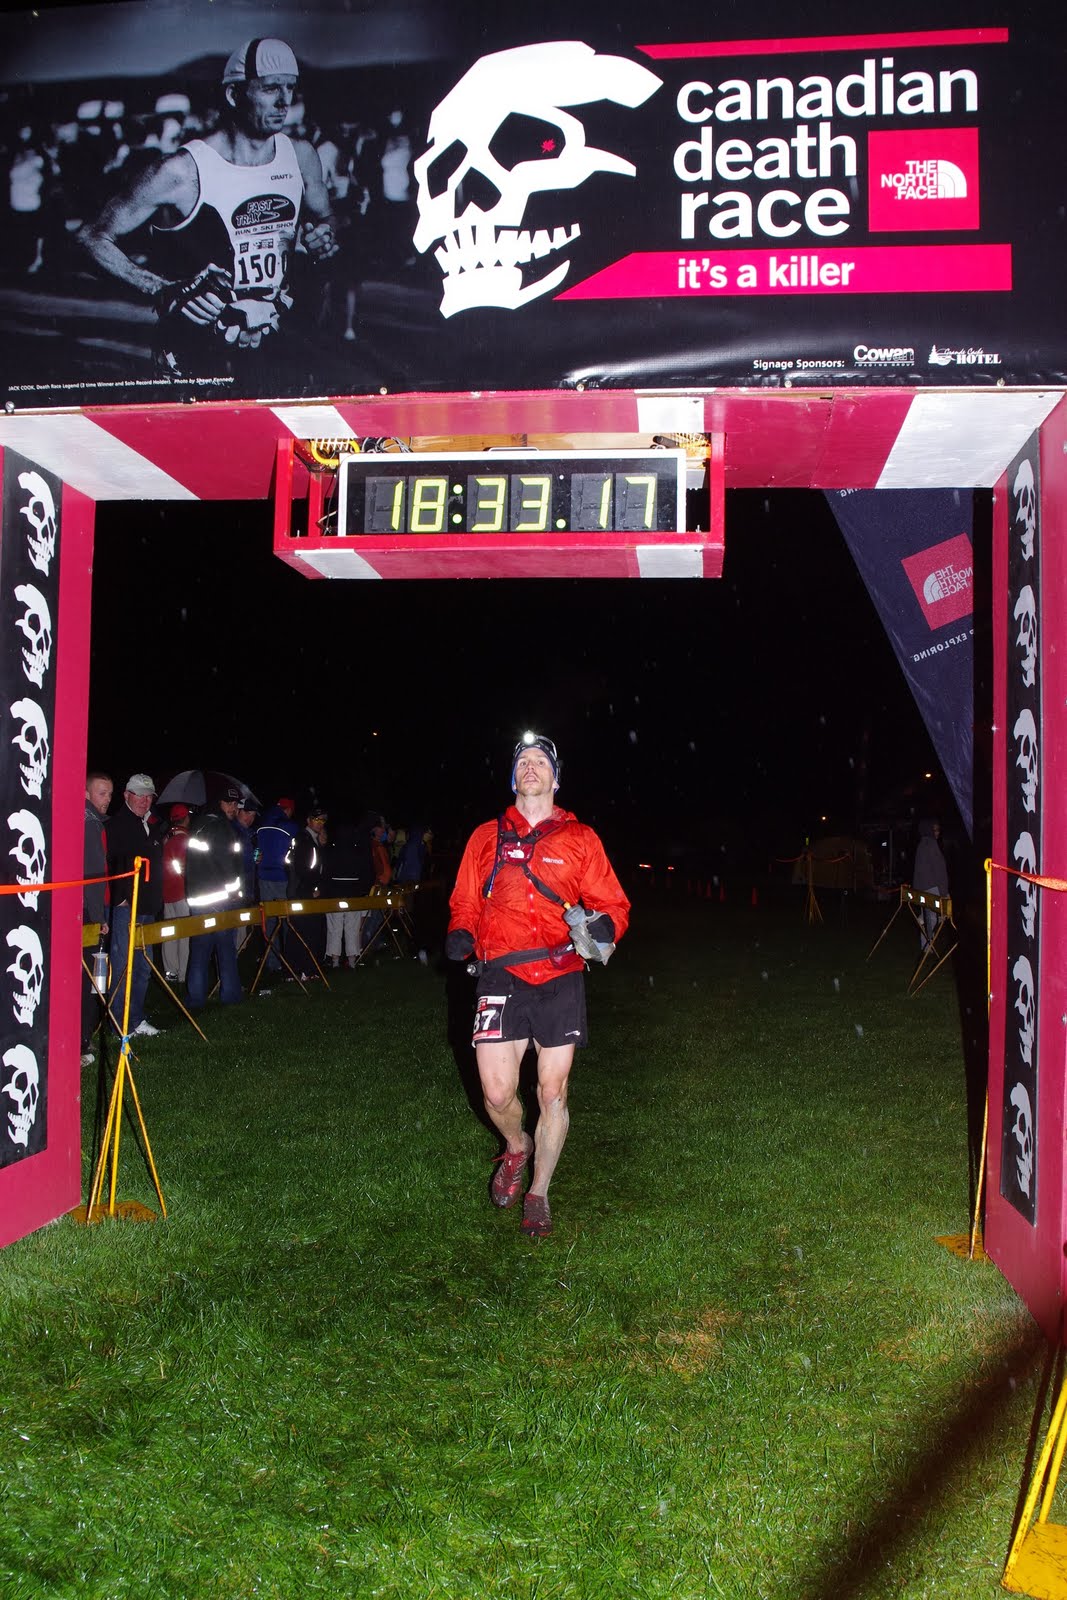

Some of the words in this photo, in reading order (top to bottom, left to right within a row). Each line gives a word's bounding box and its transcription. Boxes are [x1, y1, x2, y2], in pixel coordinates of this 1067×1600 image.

[676, 57, 978, 123] canadian
[673, 121, 857, 182] death
[905, 160, 938, 174] THE
[881, 172, 938, 188] NORTH
[896, 185, 938, 200] FACE
[246, 199, 273, 213] FAST
[681, 188, 850, 239] race
[678, 257, 728, 289] it's
[736, 263, 758, 288] a
[769, 255, 855, 288] killer
[853, 344, 915, 361] Cowan
[956, 352, 1002, 364] HOTEL
[753, 359, 794, 370] Signage
[796, 358, 845, 369] Sponsors:
